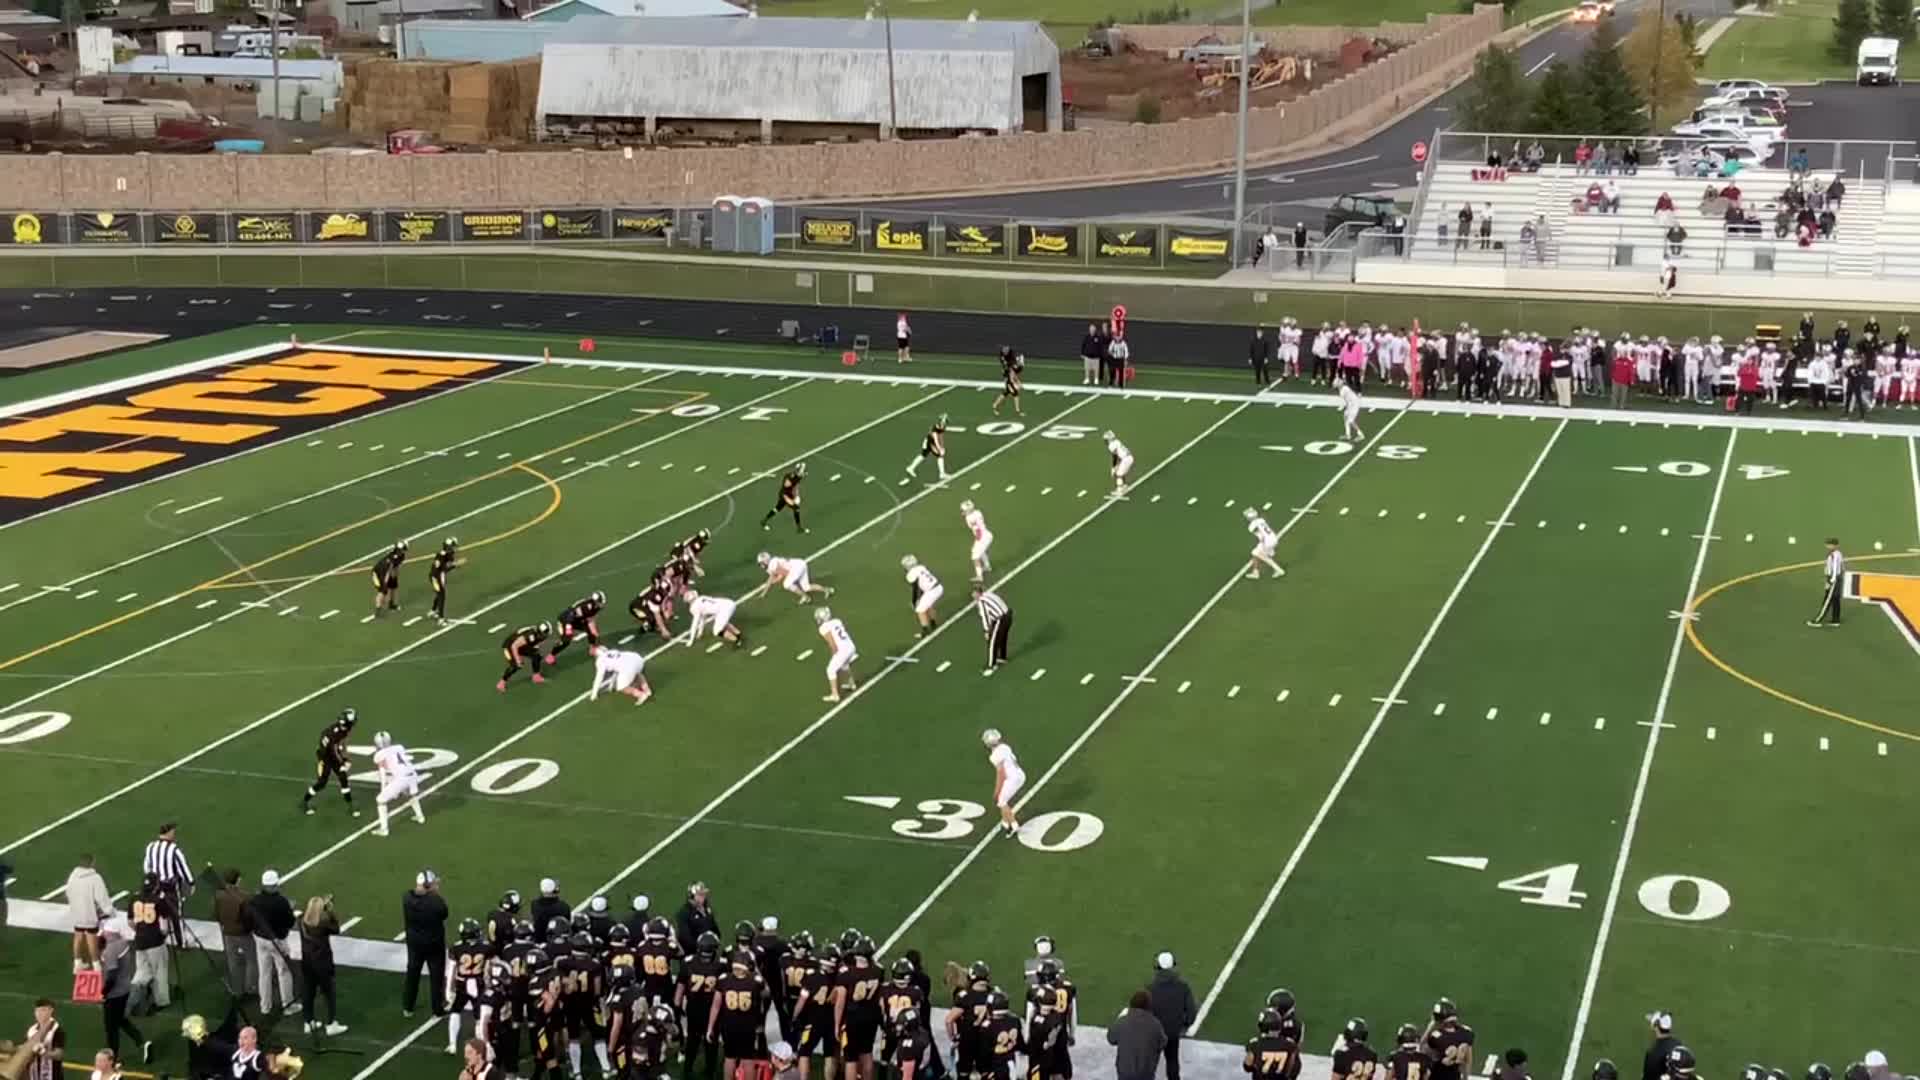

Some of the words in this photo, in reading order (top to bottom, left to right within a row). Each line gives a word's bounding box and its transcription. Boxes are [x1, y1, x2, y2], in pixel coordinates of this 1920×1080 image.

[464, 215, 522, 225] GRIDIRON
[892, 231, 922, 244] epic
[1657, 460, 1791, 480] 40
[892, 798, 1104, 851] 30
[1497, 863, 1731, 921] 40
[458, 952, 485, 976] 22
[76, 973, 99, 998] 20
[1261, 1051, 1289, 1074] 77
